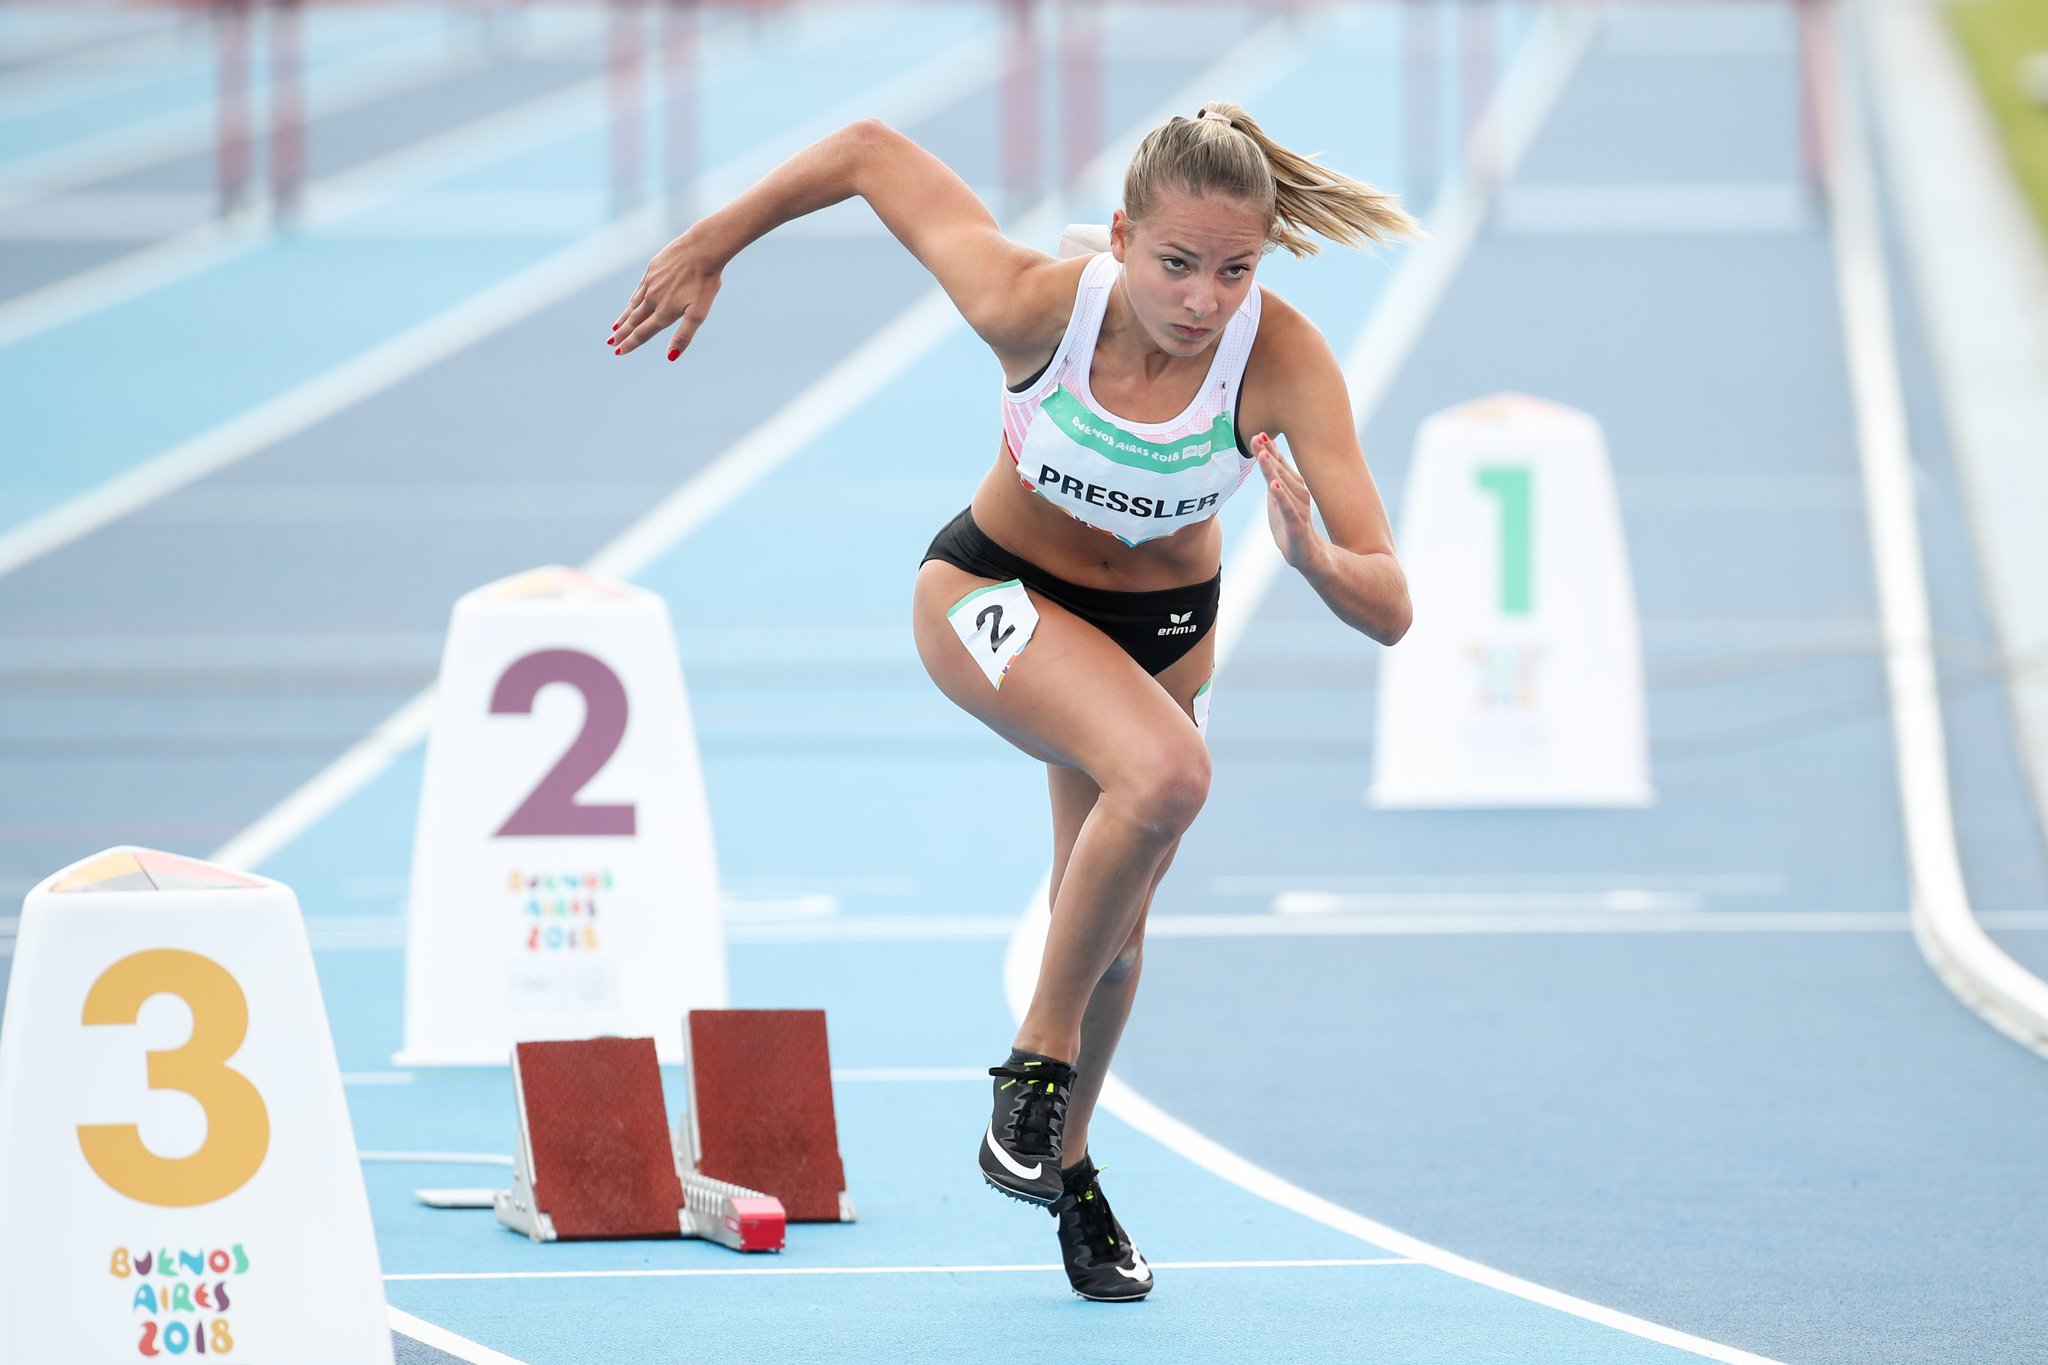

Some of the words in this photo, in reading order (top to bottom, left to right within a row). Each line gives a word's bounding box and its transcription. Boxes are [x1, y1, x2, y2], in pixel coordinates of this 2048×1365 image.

[1072, 416, 1115, 446] BUENOS
[1116, 441, 1149, 456] AIRES
[1152, 452, 1179, 462] 2018
[1038, 464, 1219, 518] PRESSLER
[1475, 464, 1532, 616] 1
[976, 604, 1016, 653] 2
[1157, 624, 1197, 636] erima
[487, 648, 637, 838] 2
[525, 925, 598, 951] 2018
[76, 948, 270, 1208] 3
[110, 1243, 249, 1278] BUENOS
[133, 1281, 230, 1314] AIRES
[138, 1317, 234, 1357] 2018
